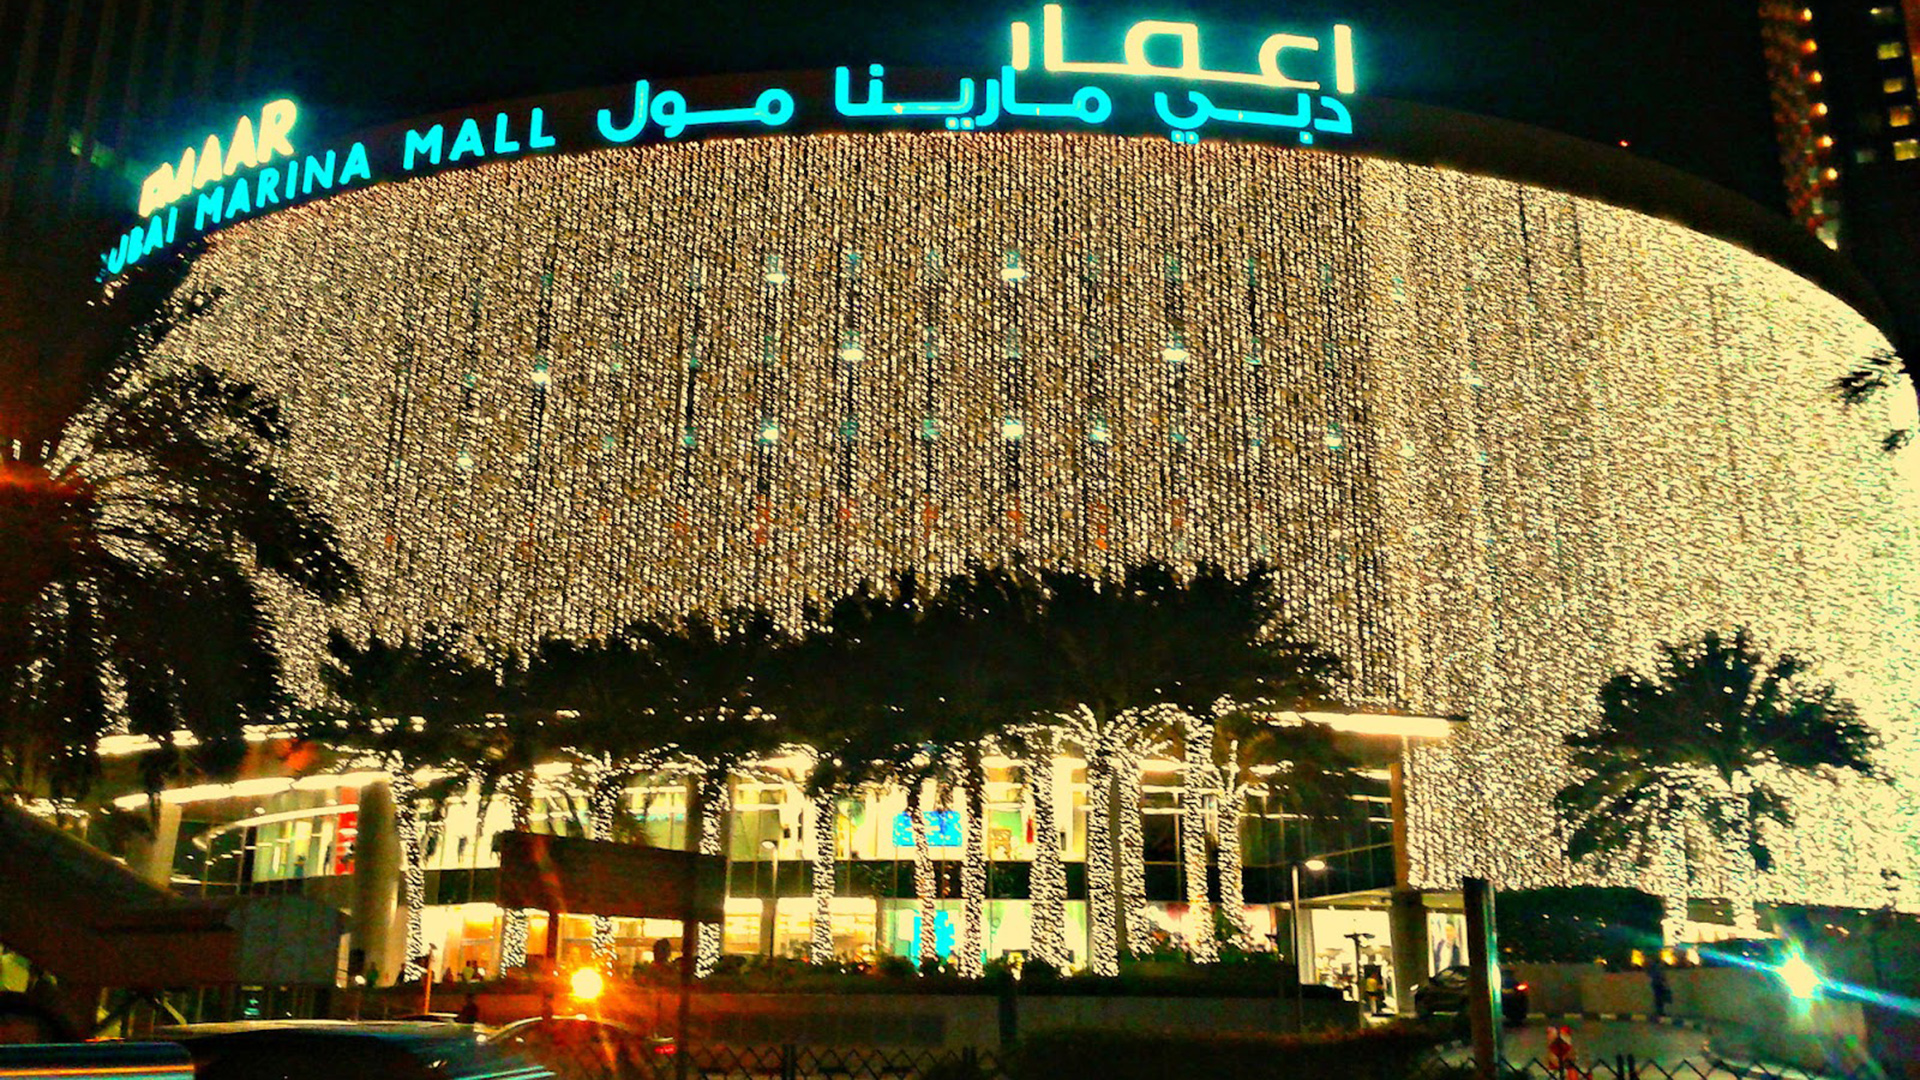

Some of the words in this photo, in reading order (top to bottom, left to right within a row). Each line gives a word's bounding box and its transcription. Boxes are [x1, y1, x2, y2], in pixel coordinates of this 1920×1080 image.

[596, 78, 795, 142] مول
[834, 63, 1113, 131] مارينا
[1154, 89, 1354, 145] دبي
[194, 141, 372, 232] MARINA
[402, 106, 556, 171] MALL
